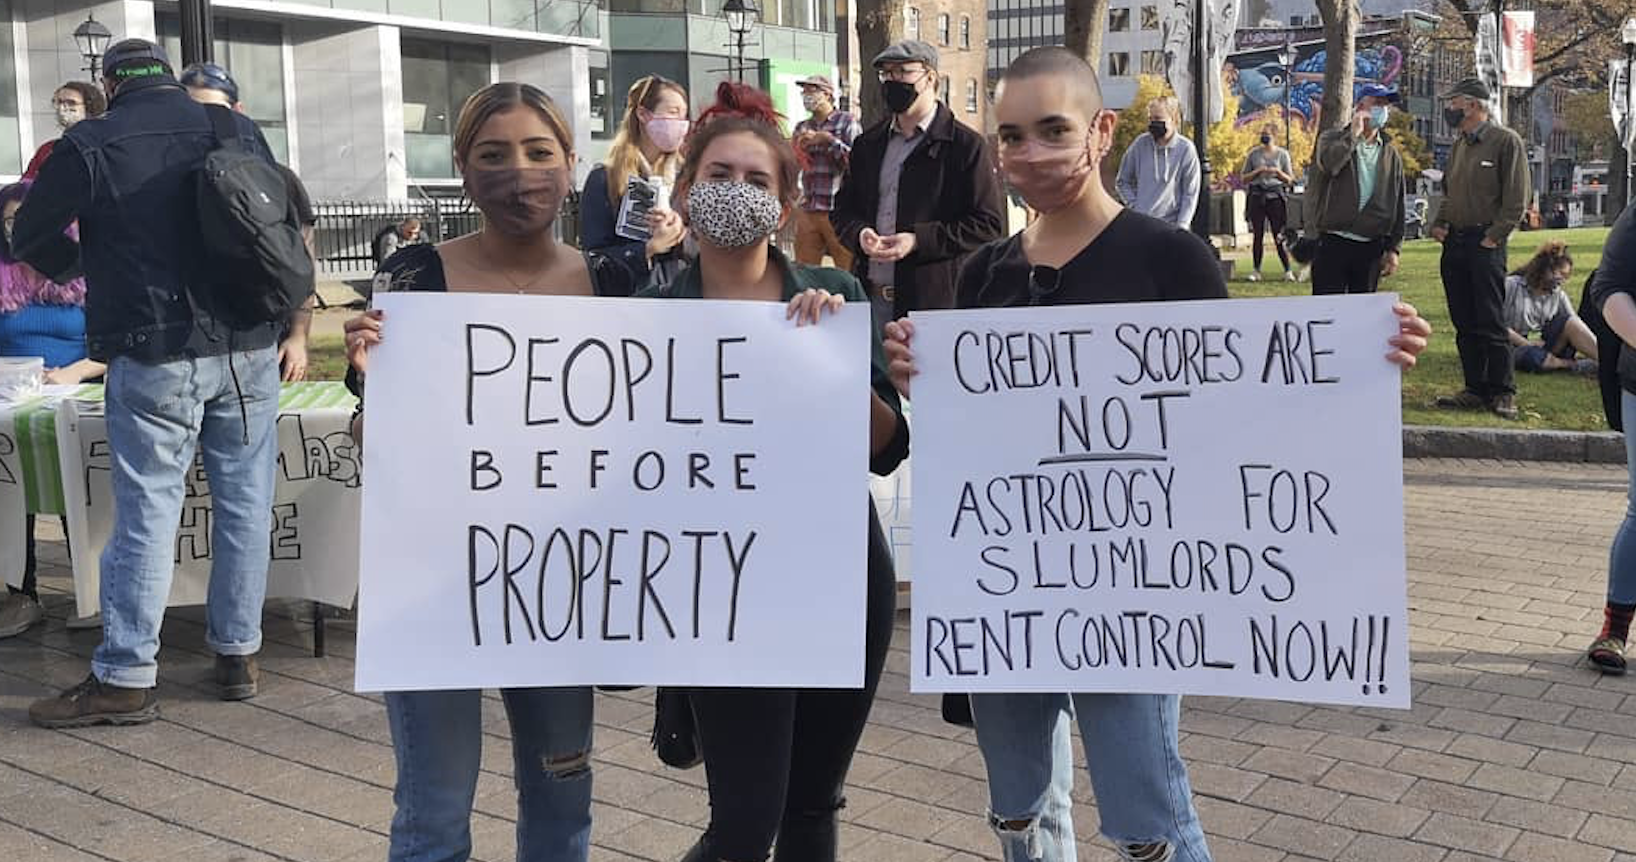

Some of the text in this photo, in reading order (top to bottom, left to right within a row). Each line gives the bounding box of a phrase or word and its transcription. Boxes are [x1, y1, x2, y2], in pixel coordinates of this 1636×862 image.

[466, 324, 755, 427] PEOPLE
[954, 320, 1340, 395] CREDIT SCORES ARE
[1057, 391, 1192, 453] NOT
[471, 450, 757, 490] BEFORE
[950, 466, 1176, 538] ASTROLOGY
[1239, 465, 1338, 536] FOR
[468, 524, 757, 646] PROPERTY
[977, 537, 1296, 603] SLUMLORDS
[926, 608, 1391, 696] RENT CONTROL NOW!!
